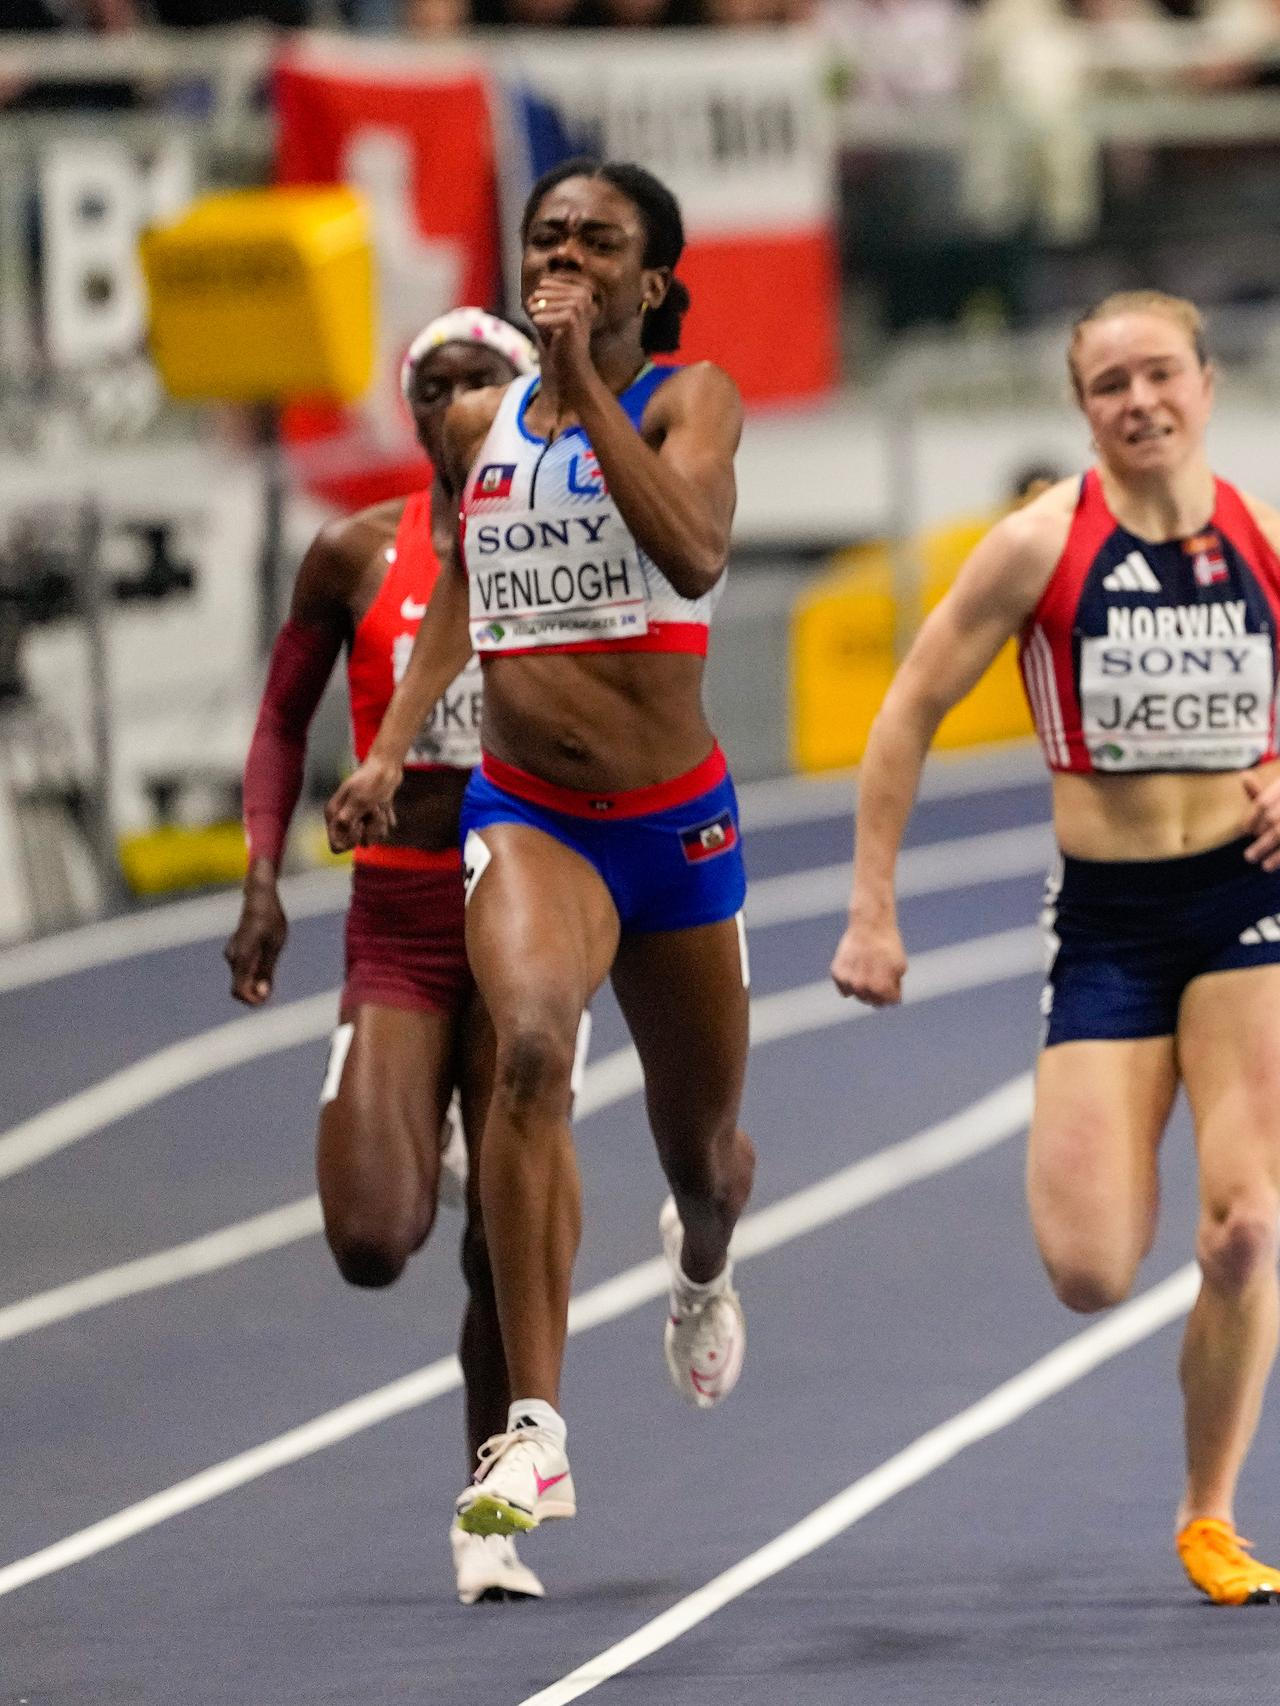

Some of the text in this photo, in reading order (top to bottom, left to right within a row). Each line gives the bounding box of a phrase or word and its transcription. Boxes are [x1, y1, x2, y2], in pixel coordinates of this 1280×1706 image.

[478, 513, 611, 555] SONY
[477, 558, 630, 611] VENLOGH
[1107, 600, 1247, 640] NORWAY
[1101, 647, 1249, 677] SONY
[1098, 692, 1259, 731] JÆGER
